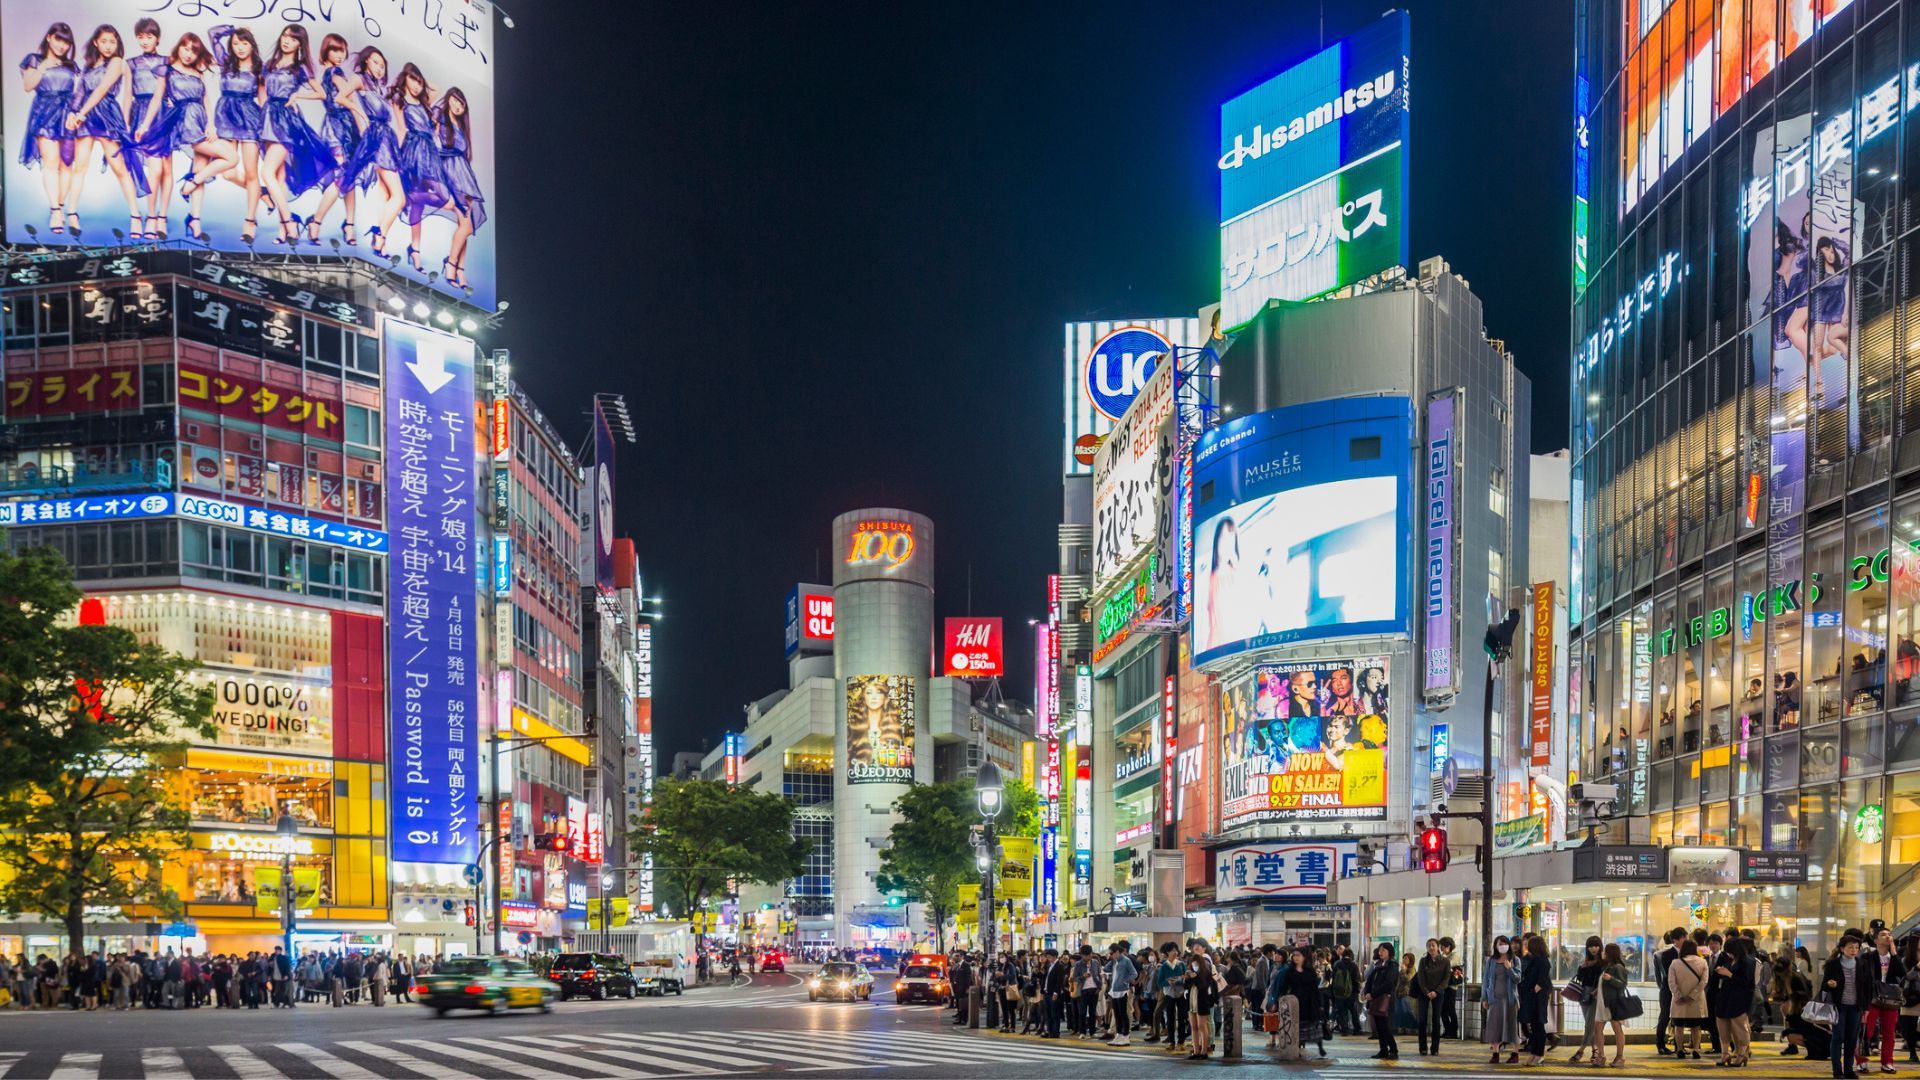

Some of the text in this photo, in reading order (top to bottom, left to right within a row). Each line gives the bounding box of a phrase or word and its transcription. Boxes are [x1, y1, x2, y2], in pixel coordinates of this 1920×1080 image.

[1218, 69, 1395, 170] Hisamitsu
[1223, 188, 1388, 291] サロンパス
[8, 371, 136, 407] プライス
[179, 369, 339, 429] コンタクト
[1220, 426, 1257, 449] Channel
[1245, 465, 1302, 487] PLATINUM
[21, 501, 137, 521] 英会話イーオン
[146, 501, 162, 511] 6F
[182, 497, 239, 522] AEON
[249, 509, 383, 548] 英会話イーオン
[859, 522, 913, 532] SHIBUYA
[1428, 429, 1449, 618] Taisei neon
[956, 623, 992, 648] H&M
[968, 660, 996, 671] 150m
[1534, 587, 1550, 758] クスリのことなら 三千里
[212, 710, 309, 733] WEDDING!
[447, 700, 466, 743] 56枚目
[1290, 752, 1325, 772] NOW
[1224, 760, 1248, 802] EXILE
[1271, 774, 1294, 794] ON
[1270, 794, 1301, 807] 9.27
[1302, 793, 1342, 806] FINAL
[1605, 863, 1638, 876] 渋谷駅
